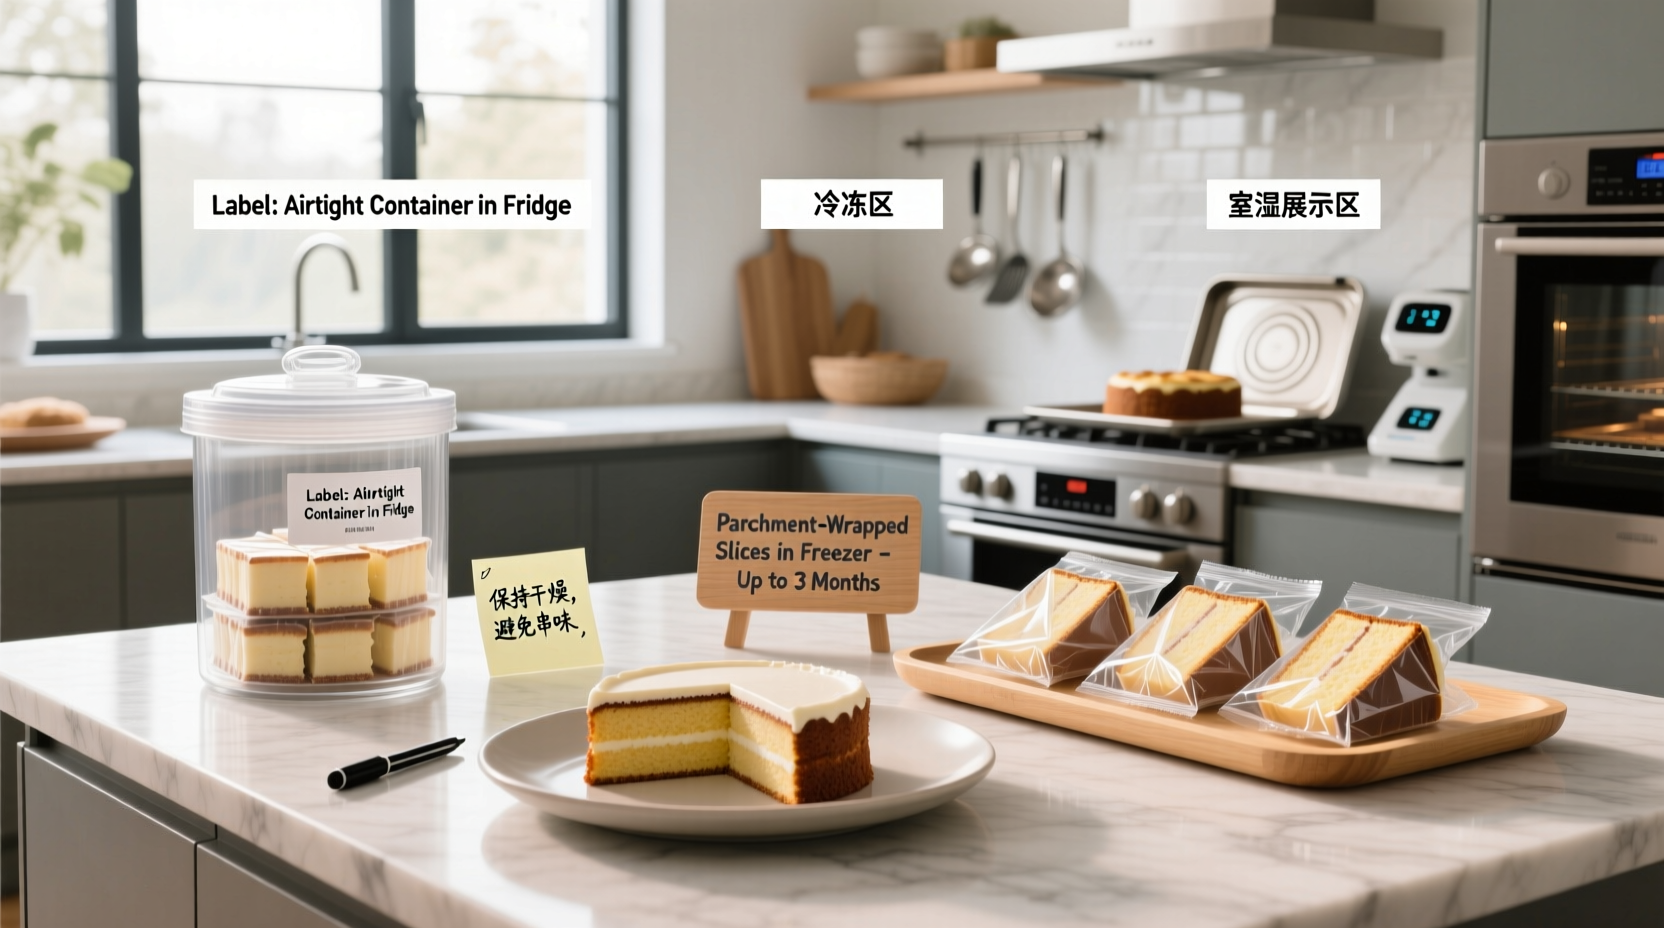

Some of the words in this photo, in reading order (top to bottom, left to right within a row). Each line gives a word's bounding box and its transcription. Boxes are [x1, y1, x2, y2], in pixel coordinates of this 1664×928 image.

[306, 487, 349, 502] Label:
[304, 506, 365, 520] Container
[716, 512, 909, 540] Parchment-Wrapped
[715, 540, 770, 561] Slices
[777, 542, 794, 561] in
[800, 542, 873, 562] Freezer
[737, 570, 763, 595] Up
[768, 571, 788, 590] to
[794, 571, 806, 591] 3
[811, 571, 881, 592] Months
